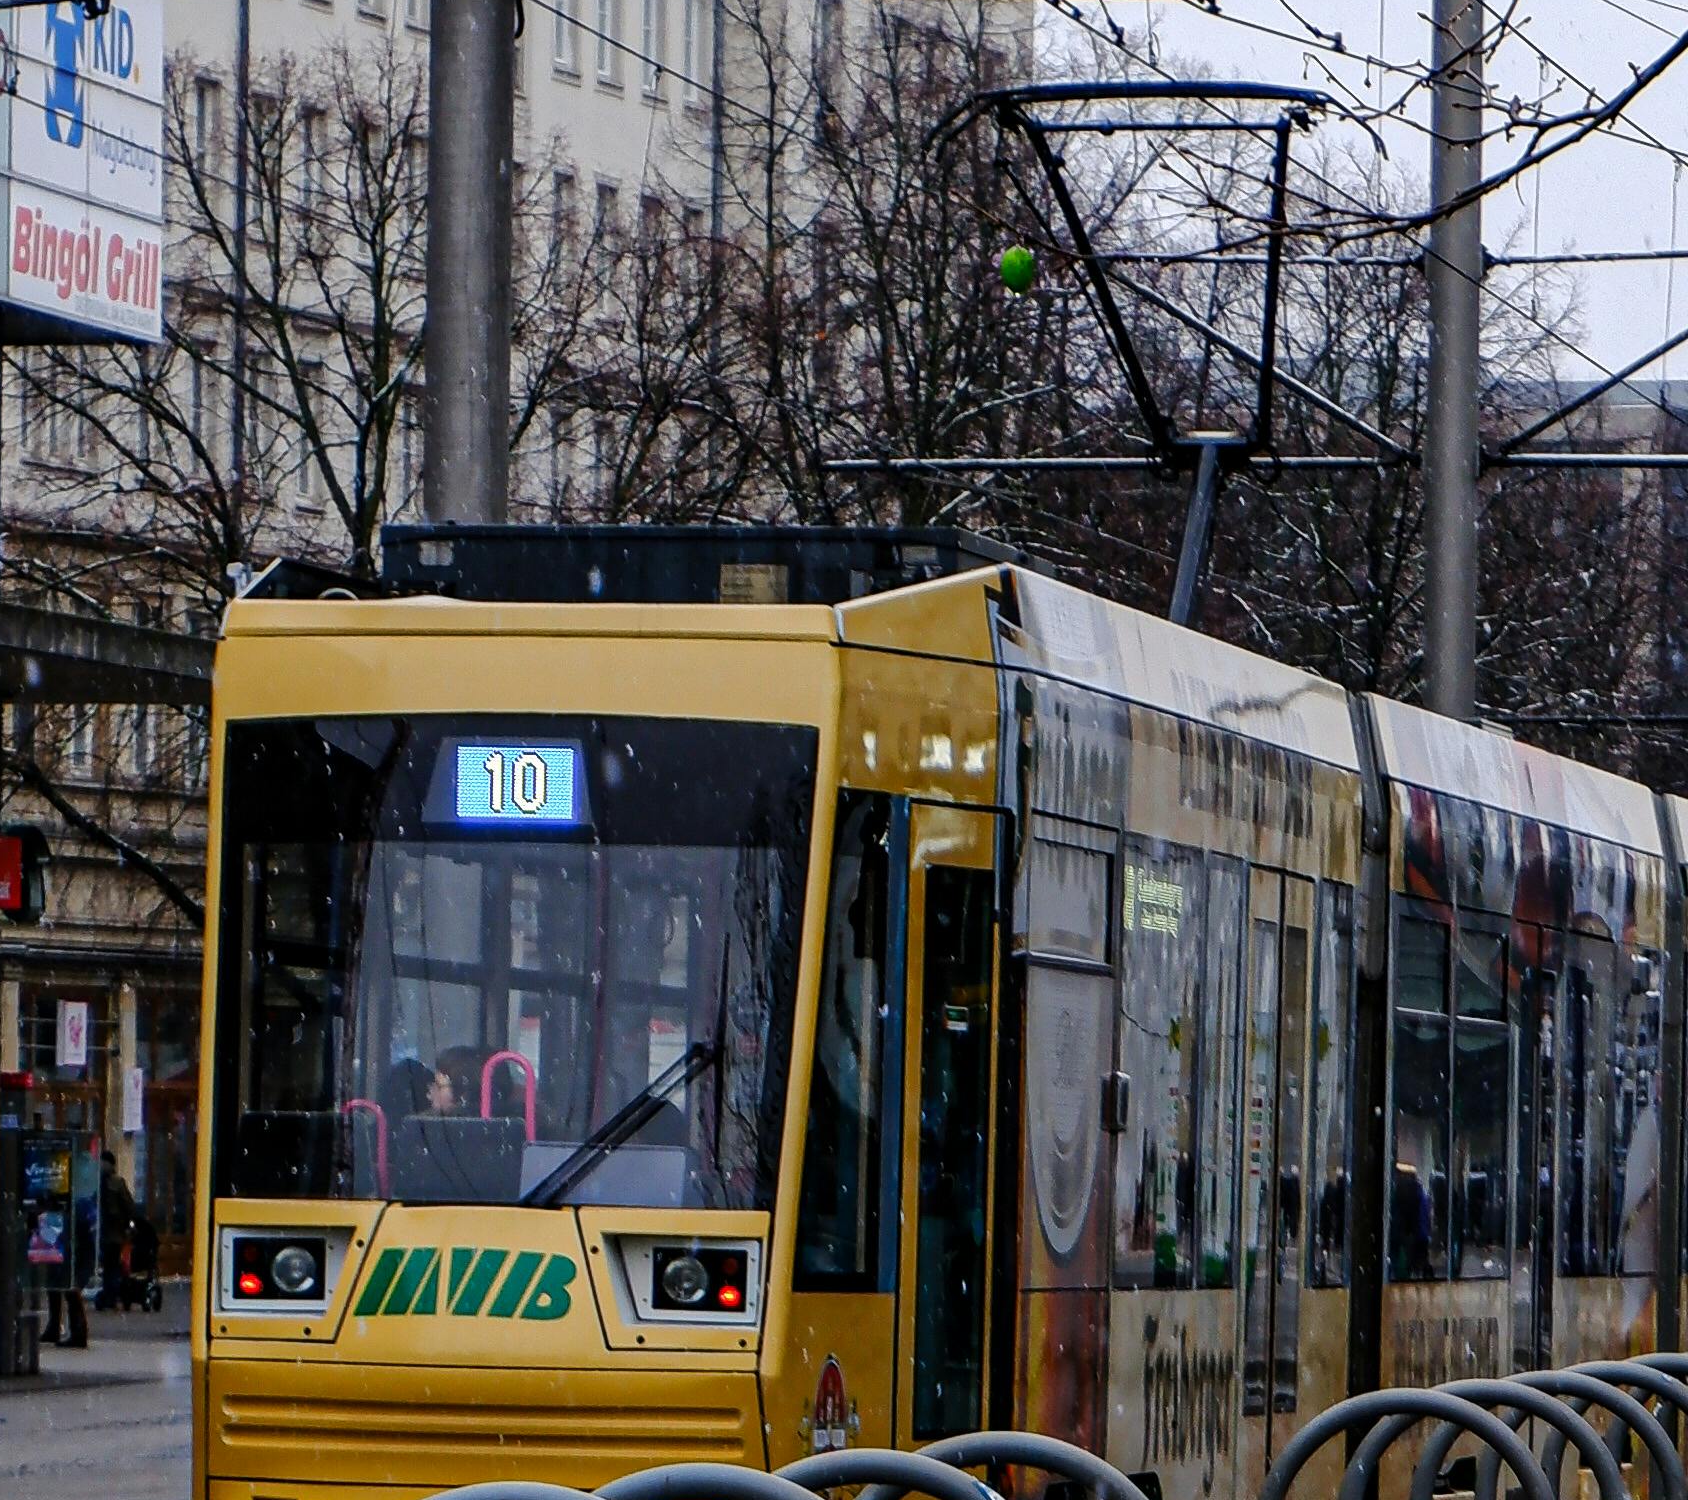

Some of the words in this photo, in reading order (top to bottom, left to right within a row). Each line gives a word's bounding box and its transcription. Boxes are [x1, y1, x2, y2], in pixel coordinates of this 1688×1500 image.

[12, 205, 101, 301] Bingöl
[106, 233, 159, 311] Grill
[483, 750, 548, 815] 10
[352, 1246, 578, 1321] MVB
